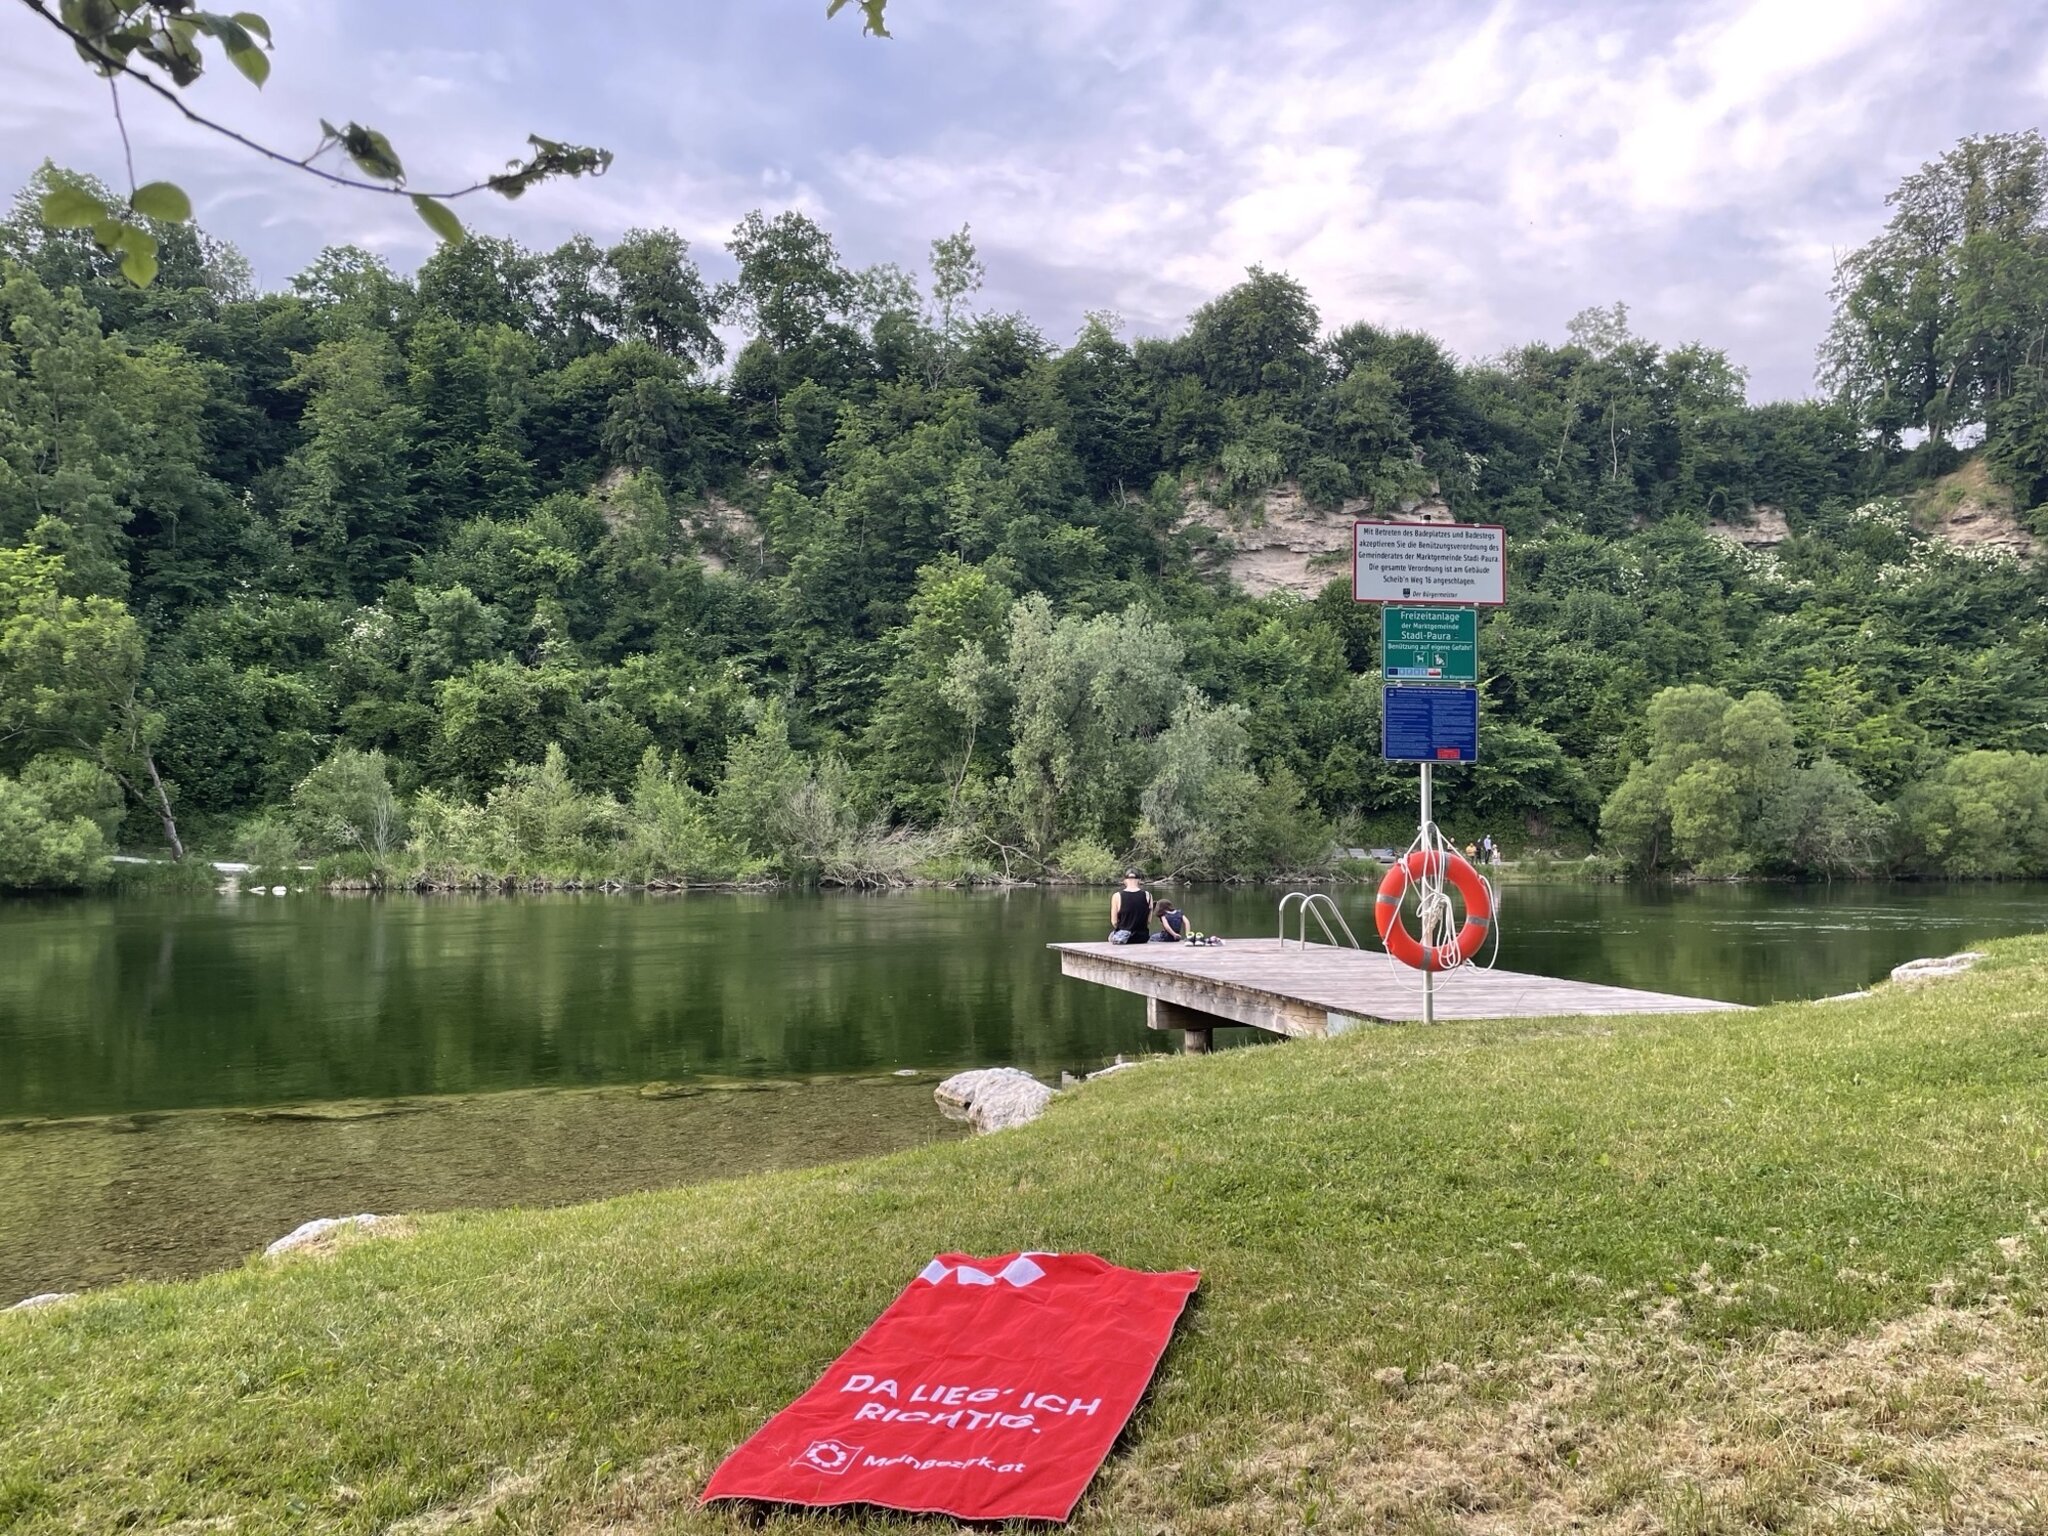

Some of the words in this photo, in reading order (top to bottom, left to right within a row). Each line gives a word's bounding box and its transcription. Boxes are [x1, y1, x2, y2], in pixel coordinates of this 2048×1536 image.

[1375, 528, 1401, 536] Betreten
[1415, 530, 1450, 538] Badeplatzes
[1465, 532, 1495, 540] Badestegs
[1359, 540, 1394, 548] akzeptieren
[1418, 541, 1487, 552] Benützungsverordnung
[1358, 552, 1403, 560] Gemeinderates
[1416, 554, 1462, 563] Marktgemeinde
[1408, 564, 1443, 573] Verordnung
[1464, 566, 1490, 574] Gebäude
[1411, 576, 1423, 584] Weg
[1400, 611, 1460, 622] Freizeitanlage
[1401, 631, 1451, 640] Stadl-Paura
[840, 1374, 898, 1401] DA
[1020, 1392, 1102, 1416] ICH
[854, 1402, 1042, 1434] RICHTIG.
[862, 1453, 1026, 1474] MeinBezirk.at
